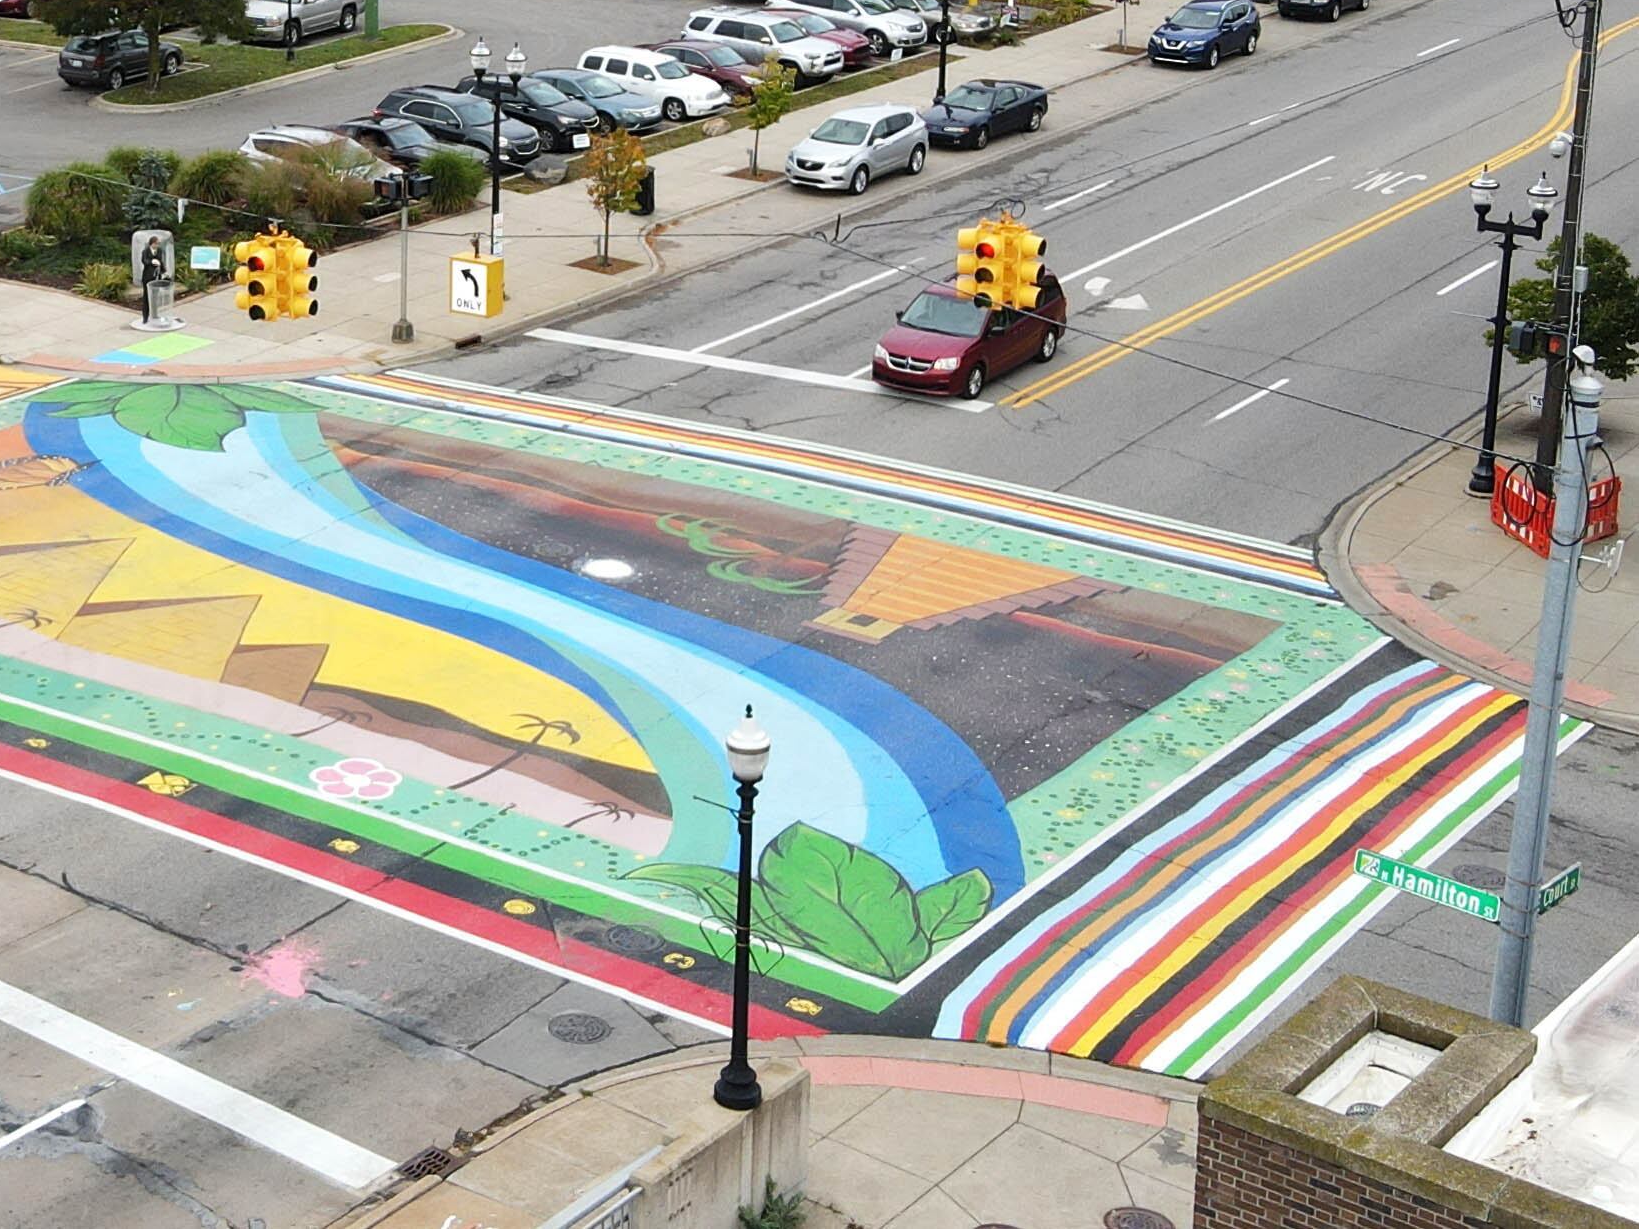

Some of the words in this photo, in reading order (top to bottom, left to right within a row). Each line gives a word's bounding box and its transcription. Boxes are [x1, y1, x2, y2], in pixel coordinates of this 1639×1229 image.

[456, 298, 482, 311] ONLY
[1392, 865, 1480, 914] Hamilton
[1543, 875, 1569, 907] Court
